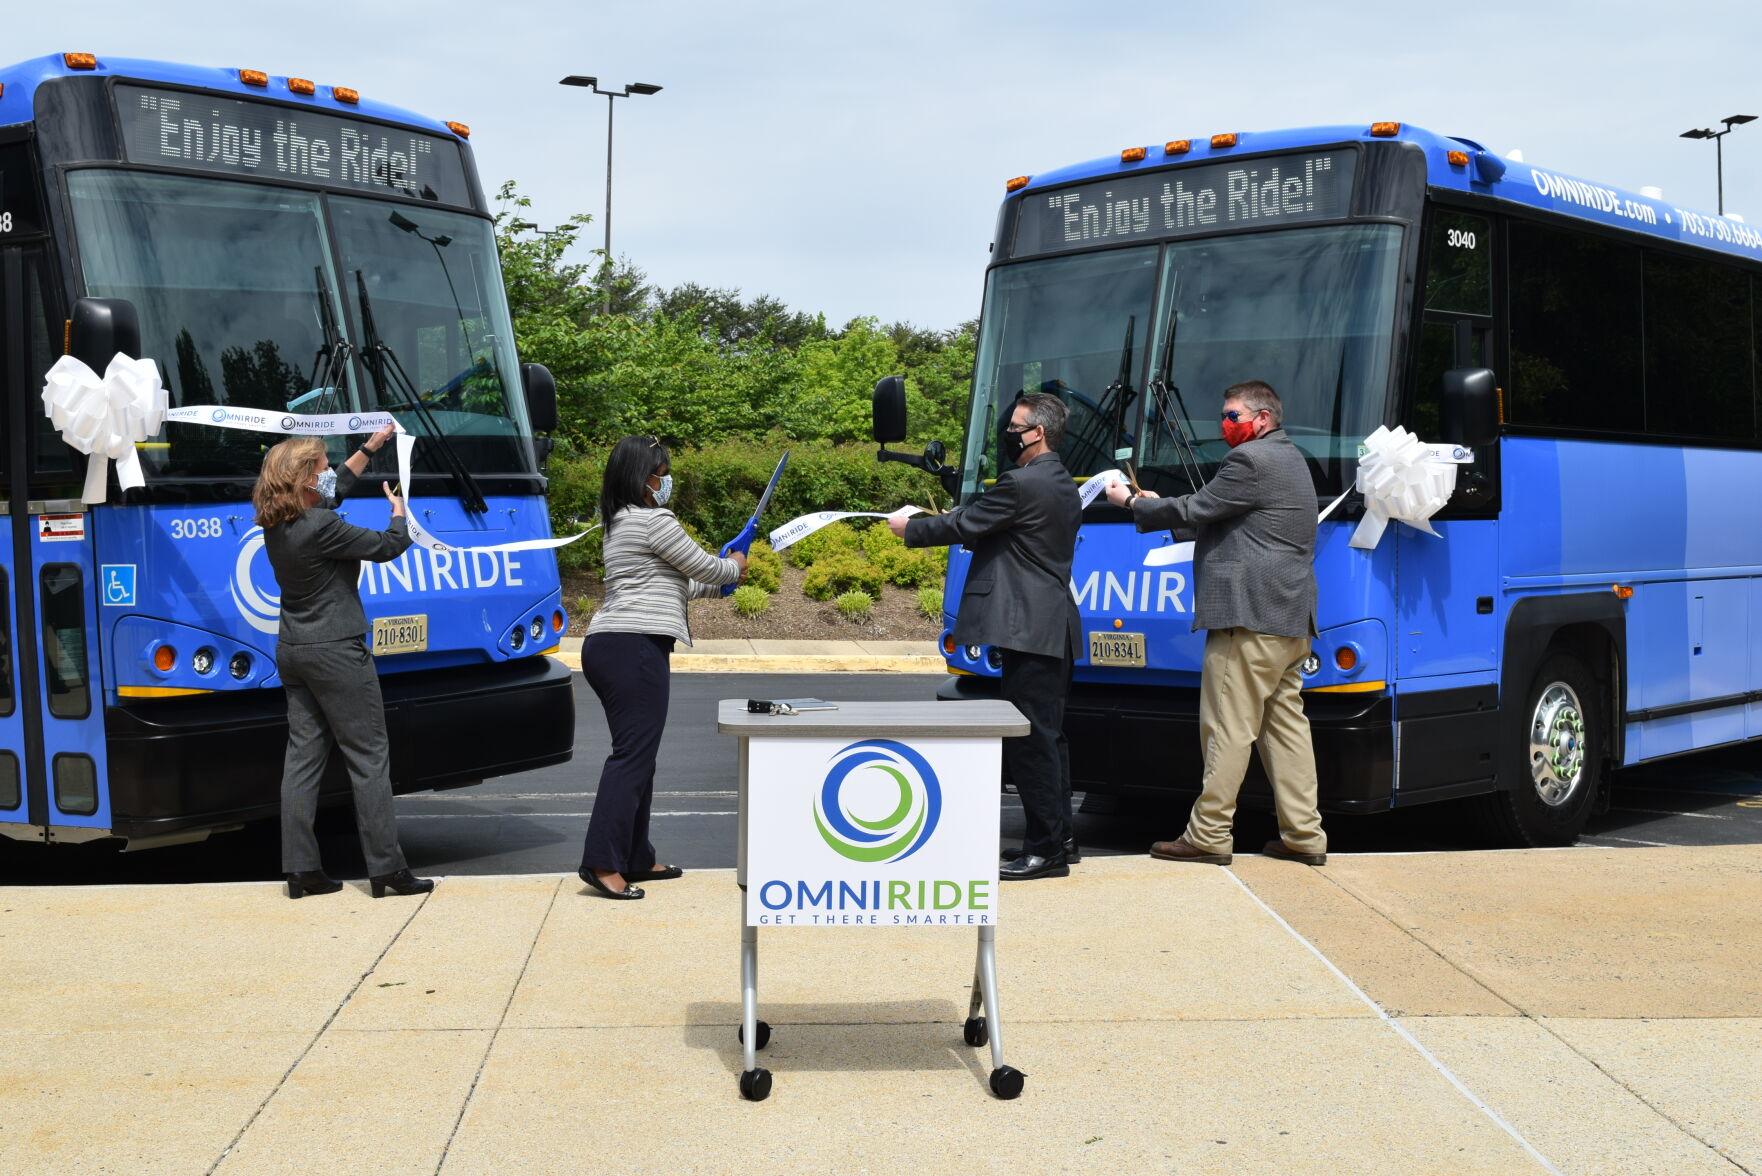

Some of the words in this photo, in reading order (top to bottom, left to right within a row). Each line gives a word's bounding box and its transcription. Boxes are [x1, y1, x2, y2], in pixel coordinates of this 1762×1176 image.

[141, 95, 261, 167] "Enjoy
[273, 120, 331, 178] the
[341, 127, 431, 190] Ride!"
[1048, 191, 1150, 241] "Enjoy
[1160, 181, 1217, 229] the
[1227, 157, 1331, 221] Ride!"
[1530, 168, 1657, 225] OMNIRIDE.com
[1447, 228, 1476, 250] 3040
[348, 415, 394, 431] OMNIRID
[170, 516, 223, 540] 3038
[759, 880, 990, 911] OMNIRIDE
[759, 914, 797, 925] GET
[812, 914, 878, 925] THERE
[892, 914, 989, 925] SMARTER
